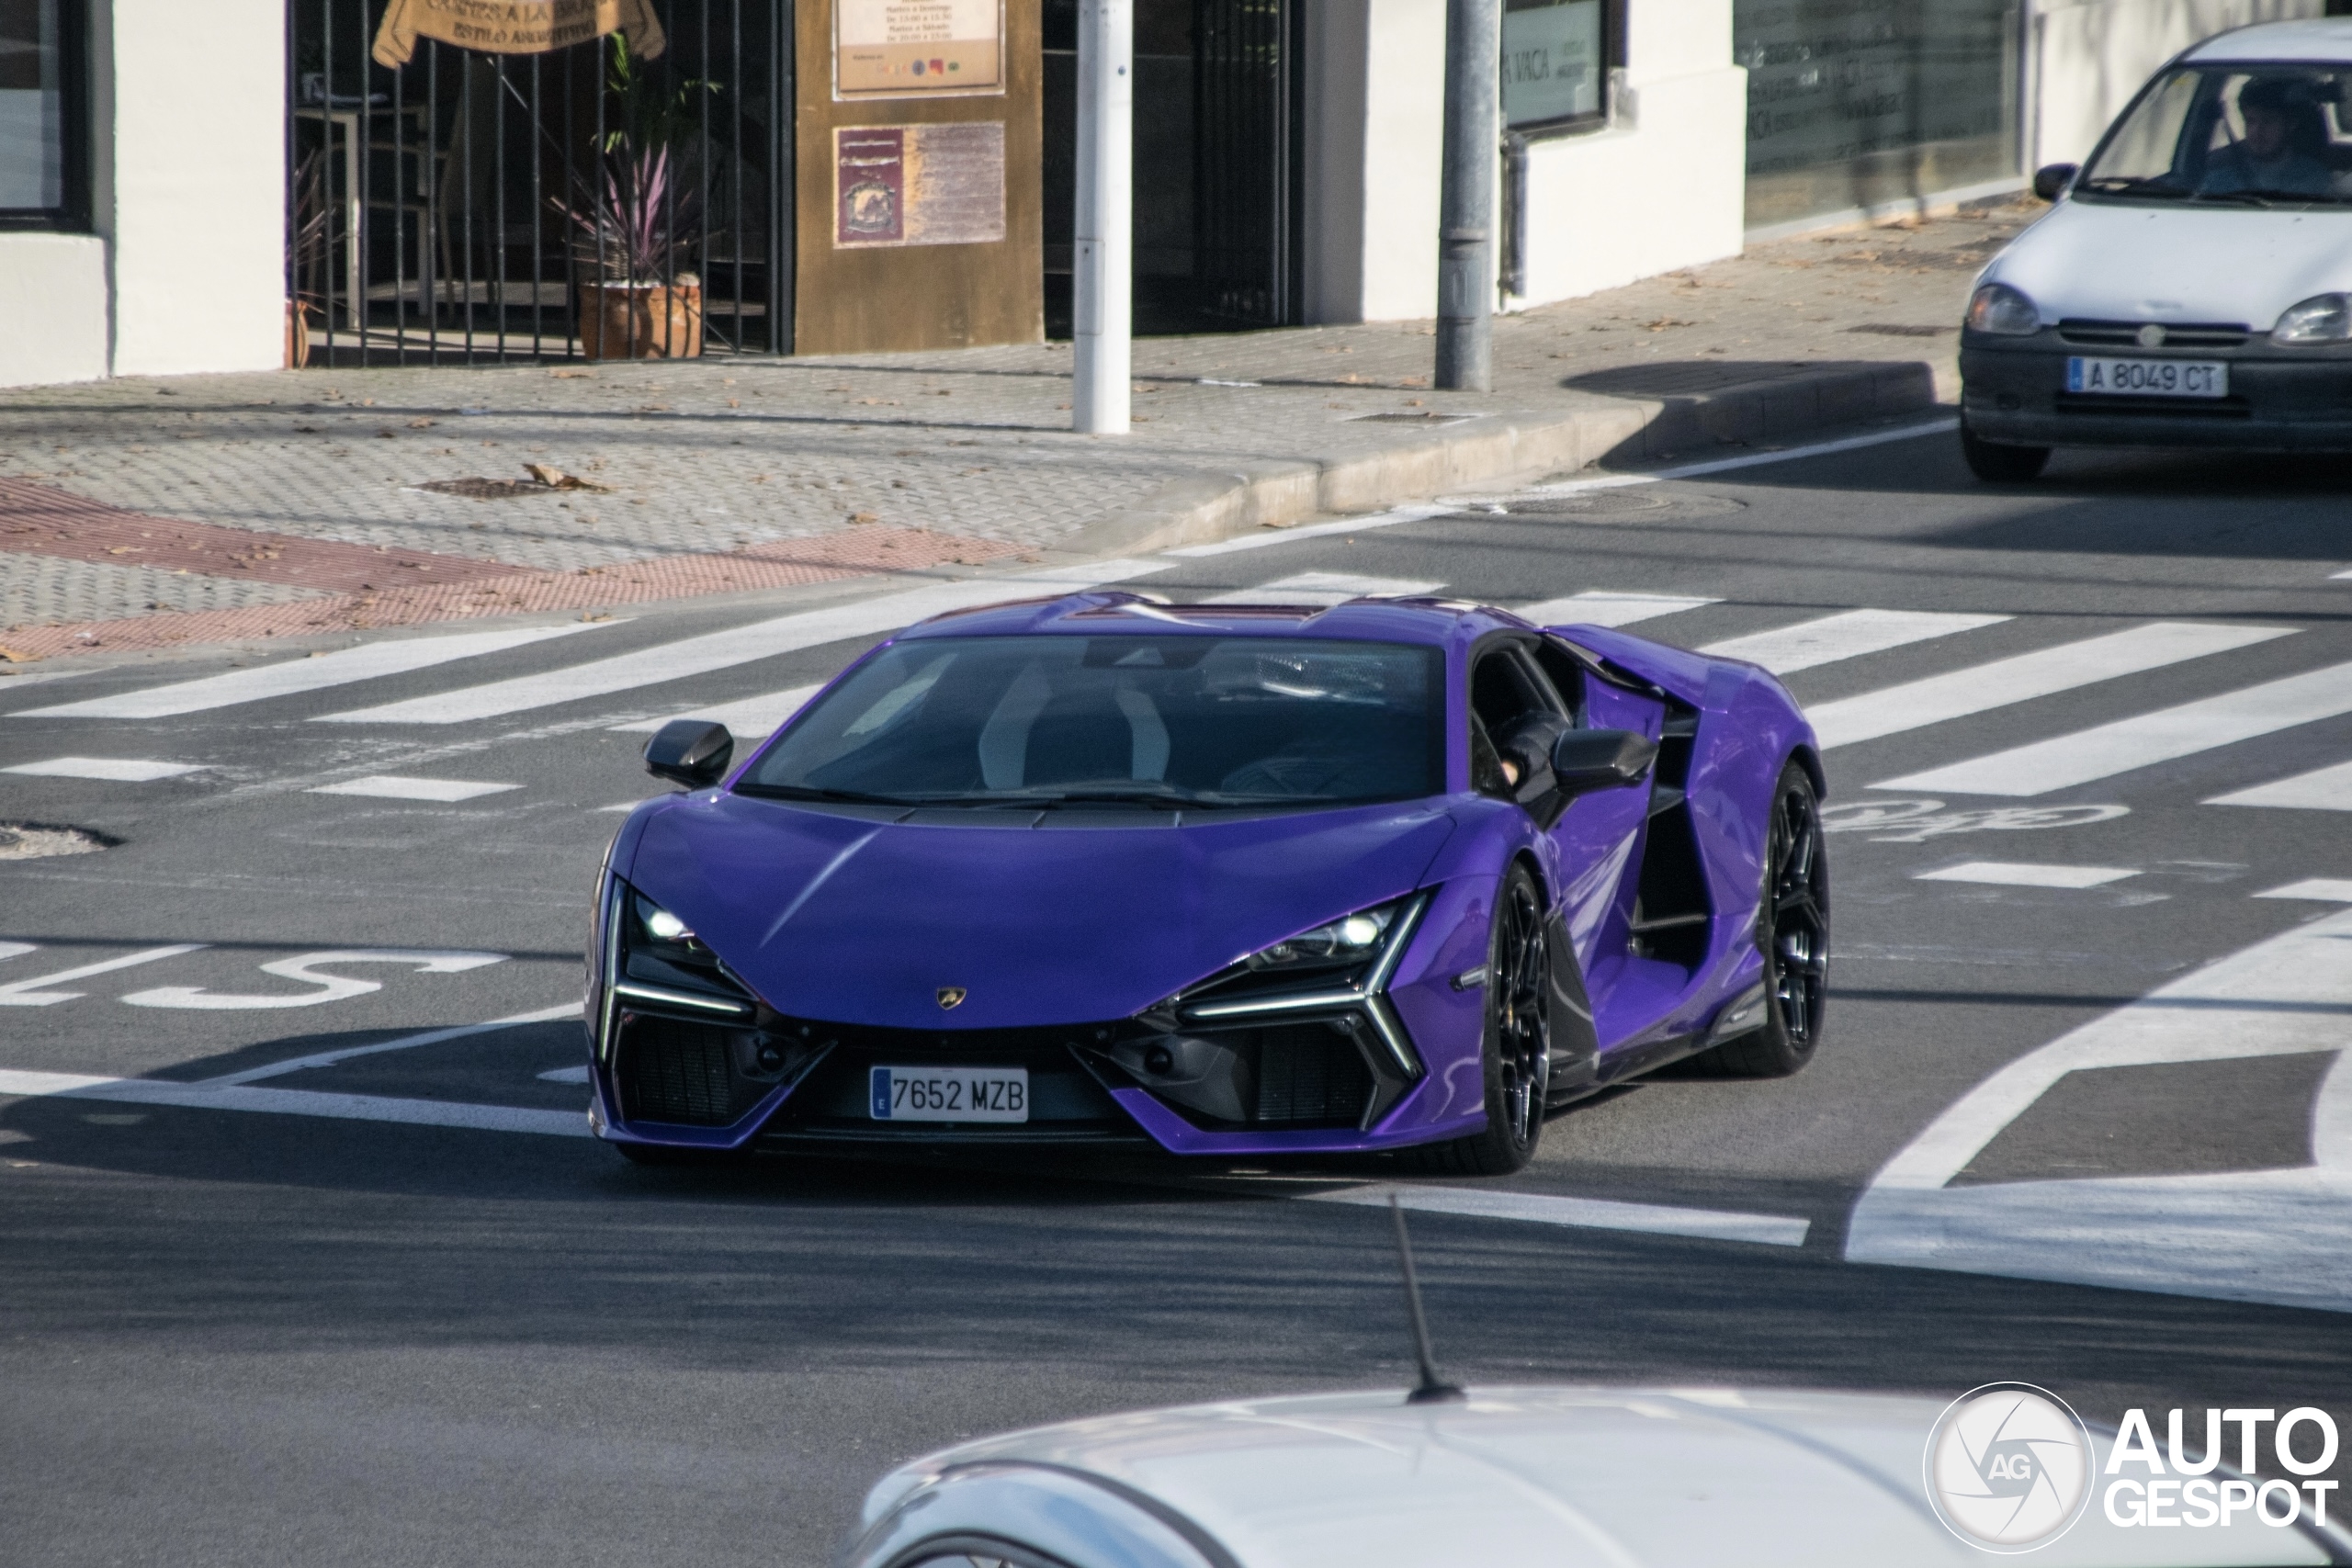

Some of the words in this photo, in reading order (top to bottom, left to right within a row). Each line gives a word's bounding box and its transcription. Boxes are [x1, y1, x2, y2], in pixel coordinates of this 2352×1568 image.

[2090, 362, 2105, 389] A
[2115, 363, 2177, 390] 8049
[2186, 366, 2217, 391] CT
[893, 1079, 962, 1111] 7652
[971, 1080, 1024, 1111] MZB
